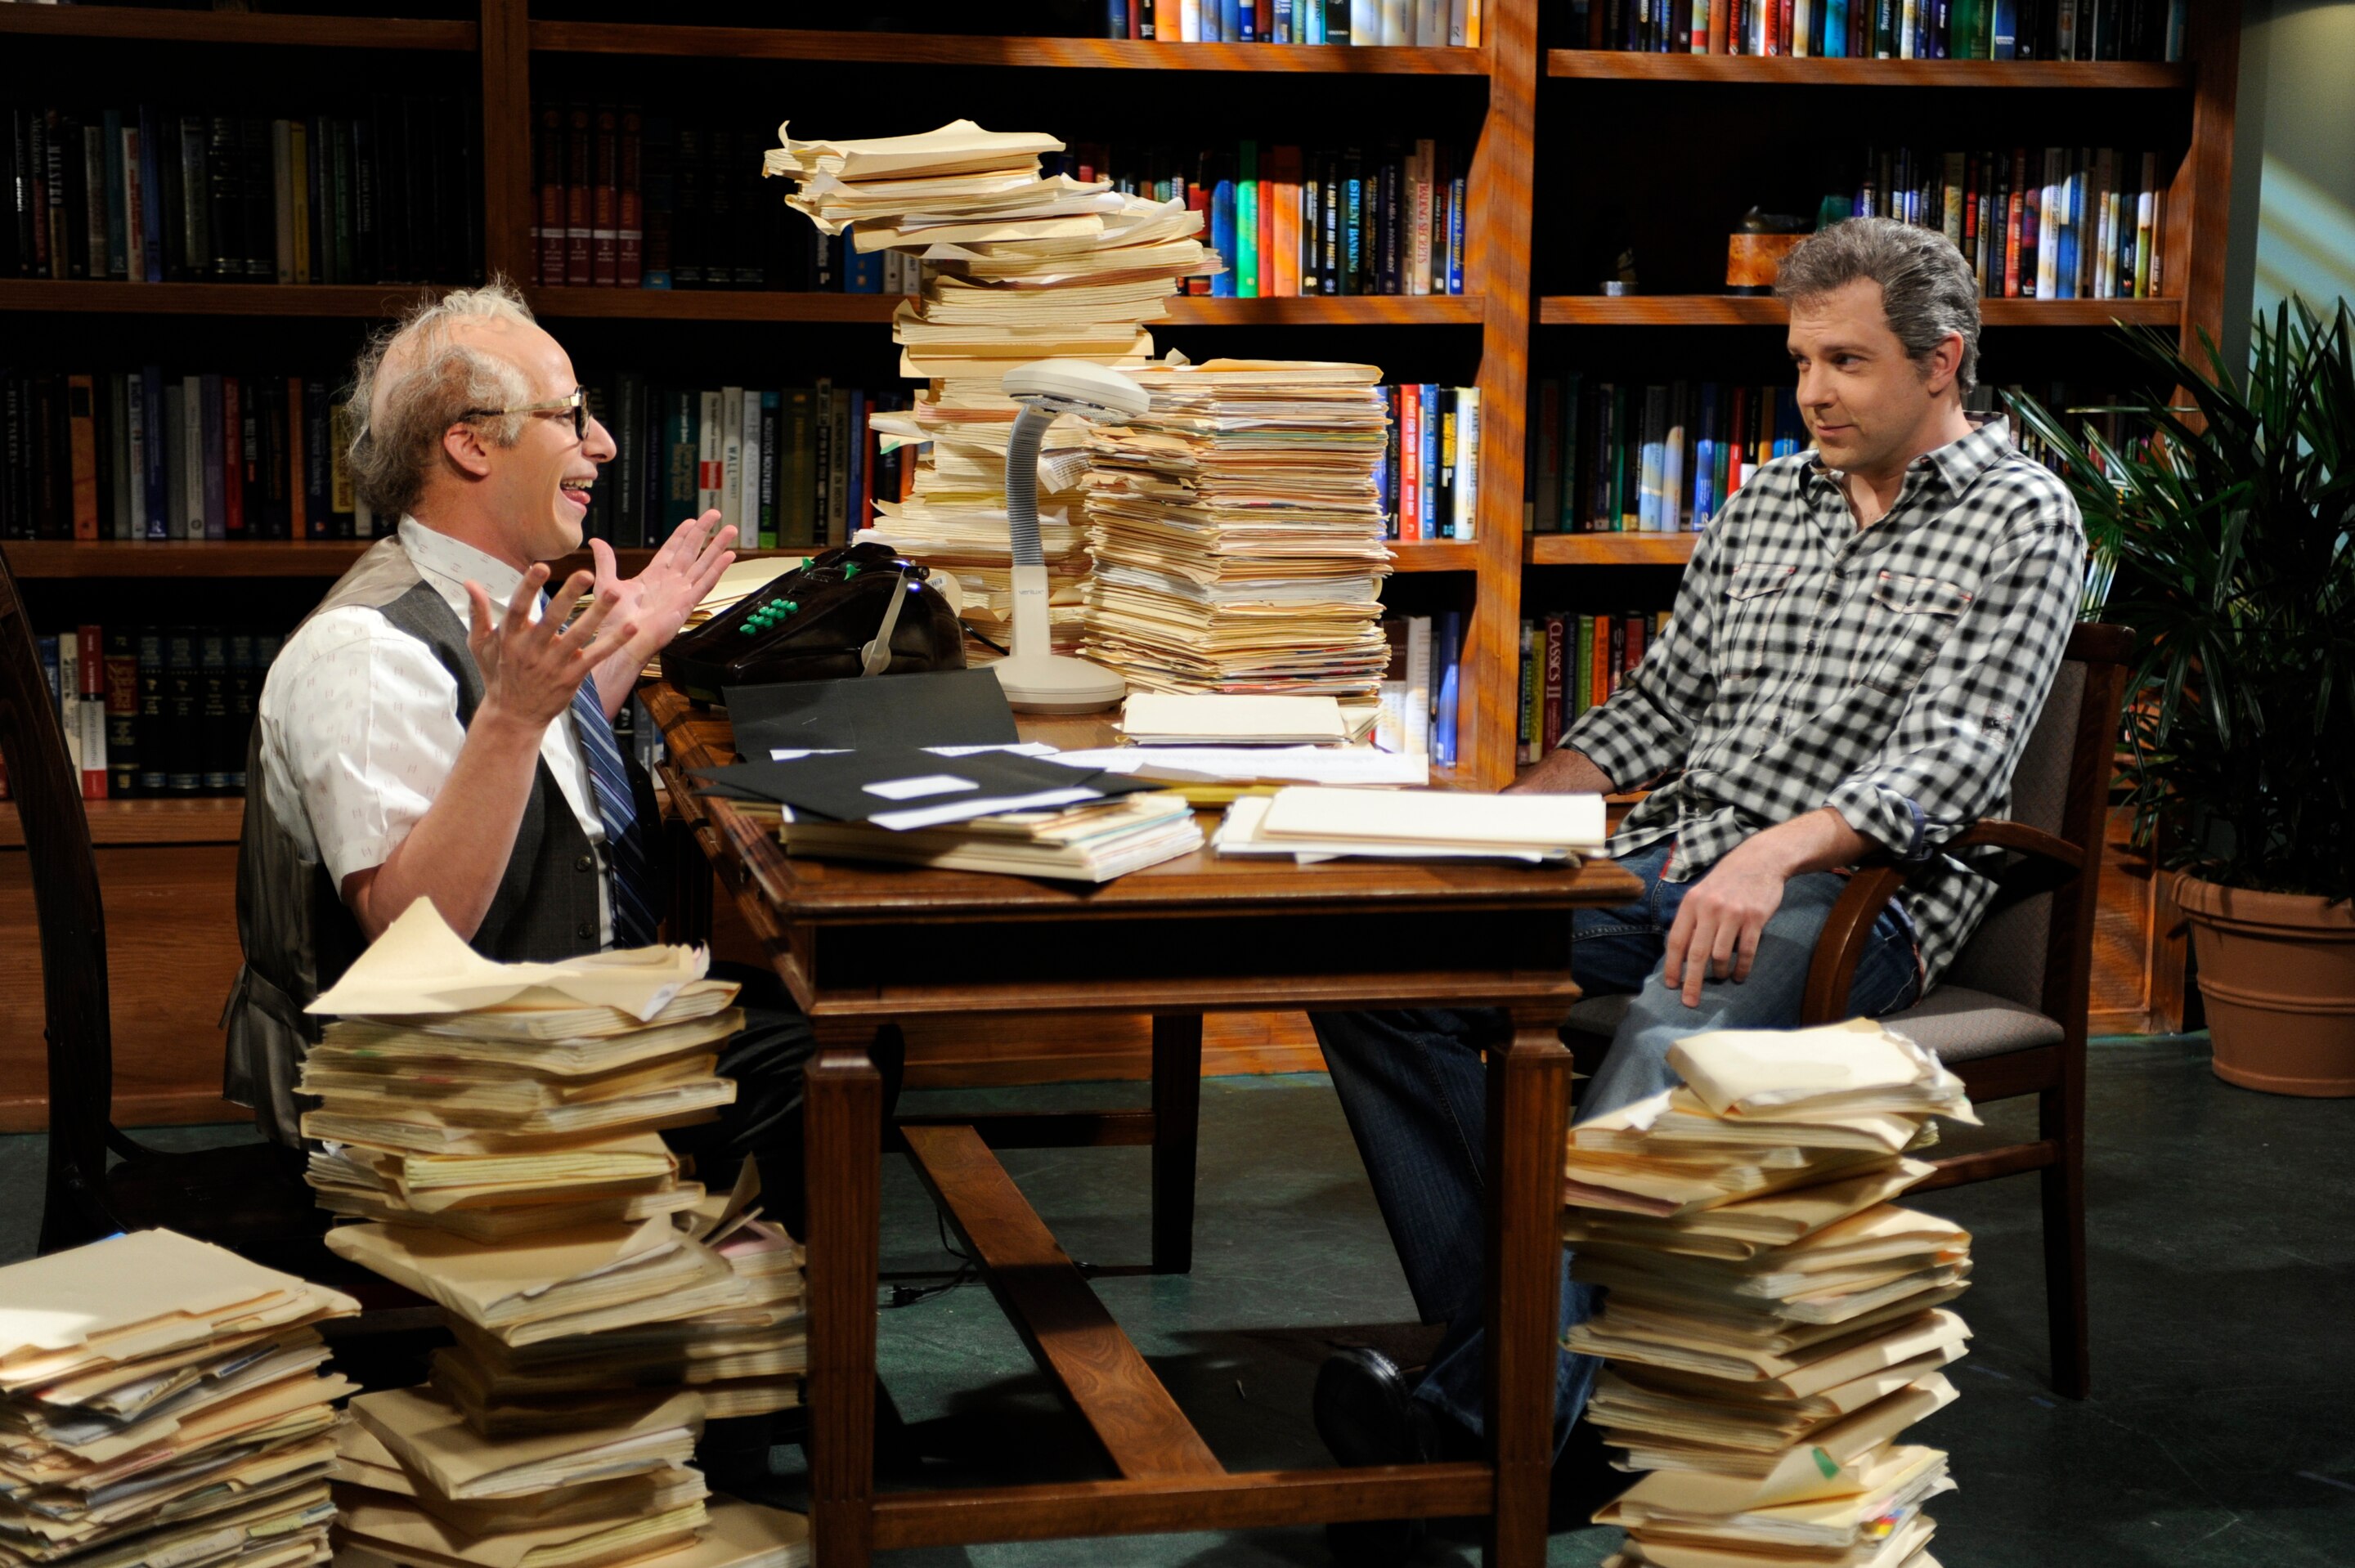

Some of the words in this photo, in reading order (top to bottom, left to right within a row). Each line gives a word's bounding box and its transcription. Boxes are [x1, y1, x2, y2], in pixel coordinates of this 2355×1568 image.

[48, 146, 62, 204] MAESTRO
[1326, 190, 1336, 208] ALPHA
[1418, 181, 1429, 220] TRADING
[1326, 208, 1336, 229] THEORY
[2051, 210, 2060, 240] Success
[1326, 230, 1336, 242] AND
[1418, 223, 1429, 264] SECRETS
[1326, 243, 1336, 269] PRACTICE
[1348, 228, 1360, 273] BANKING
[1407, 396, 1415, 418] FIGHT
[1427, 392, 1435, 413] START
[765, 417, 774, 455] SOLUTION
[1407, 419, 1415, 432] FOR
[7, 419, 18, 464] TAKERS
[836, 413, 845, 472] UNEMPLOYMENT
[1407, 434, 1415, 454] YOUR
[1427, 437, 1435, 463] FINISH
[727, 446, 738, 475] WALL
[1407, 455, 1415, 481] MONEY
[1427, 464, 1435, 484] RICH
[763, 455, 773, 504] ARBITRATION
[1391, 460, 1399, 500] HUNTERS
[1550, 621, 1563, 682] CLASSICS
[1547, 685, 1562, 700] II
